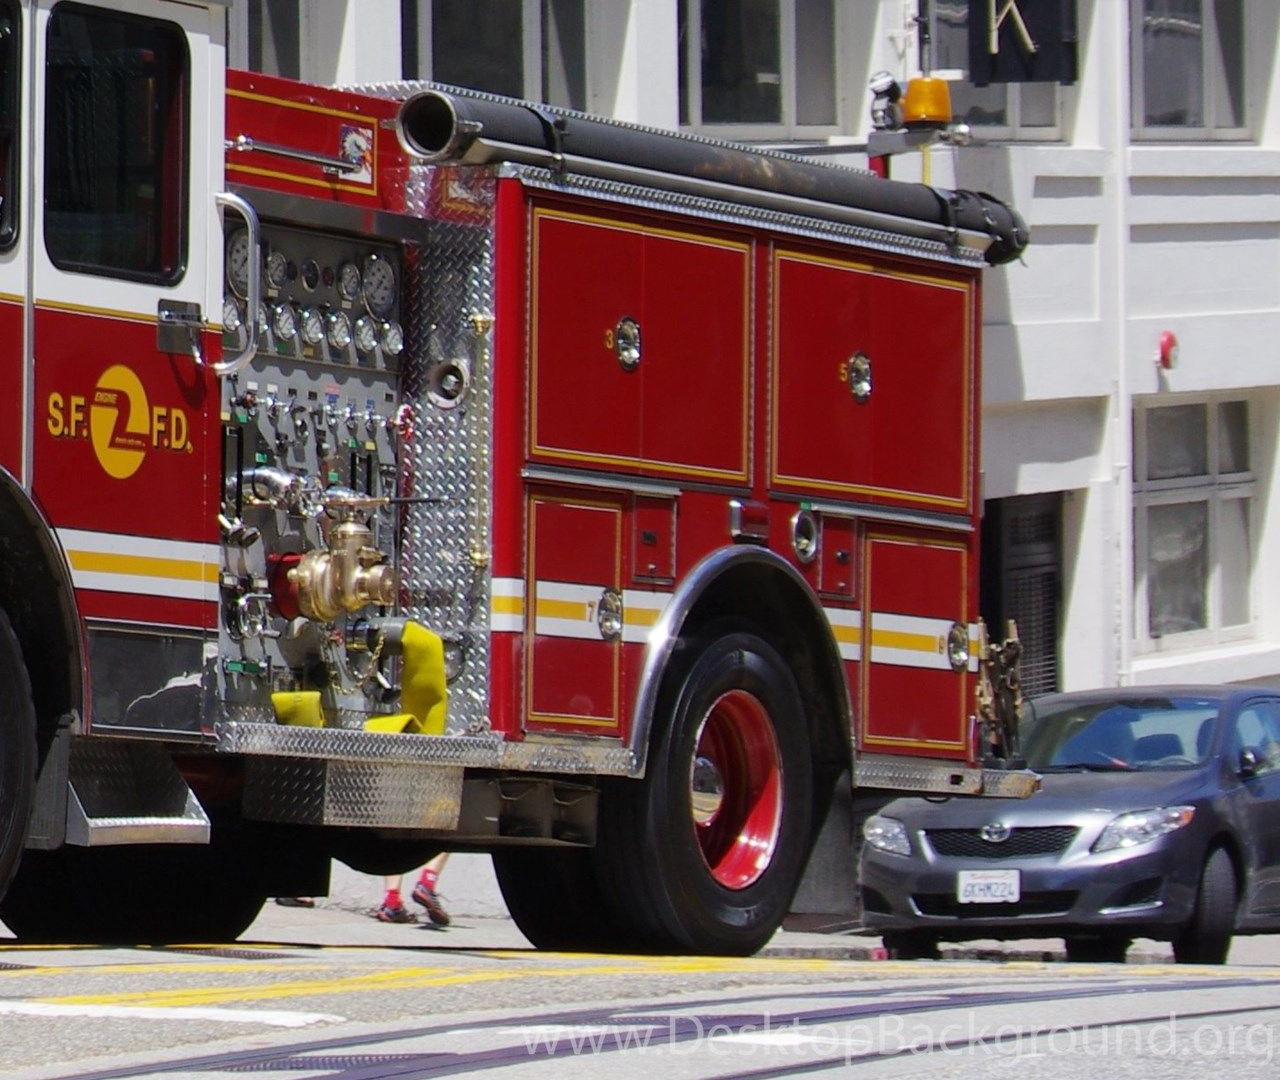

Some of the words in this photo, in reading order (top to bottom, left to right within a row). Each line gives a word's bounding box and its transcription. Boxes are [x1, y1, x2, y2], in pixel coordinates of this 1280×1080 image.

[606, 329, 614, 349] 3
[839, 362, 848, 382] 5
[47, 391, 89, 438] S.F.
[152, 404, 195, 455] F.D.
